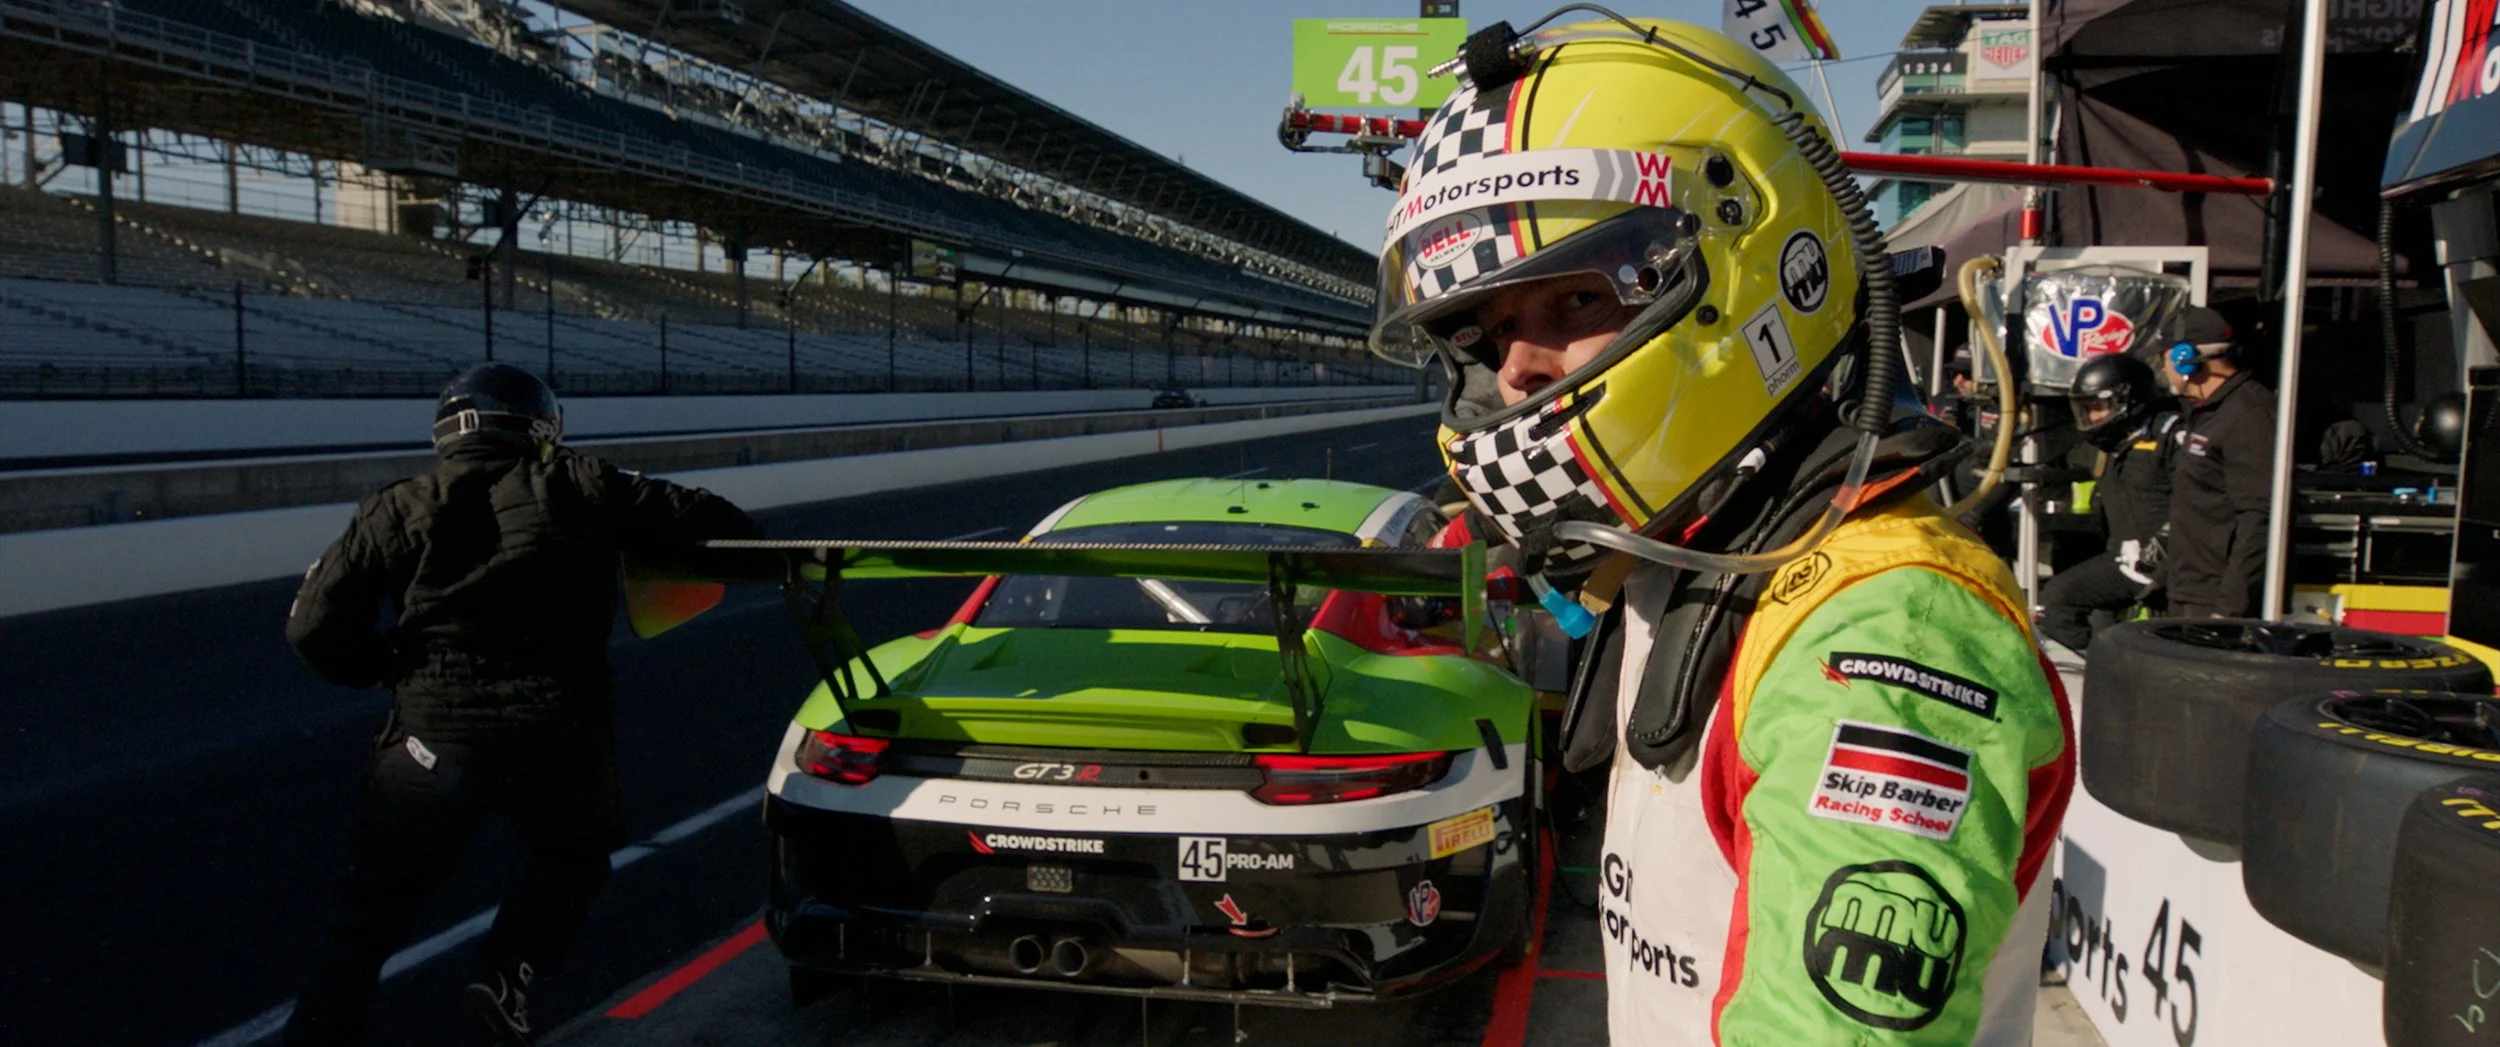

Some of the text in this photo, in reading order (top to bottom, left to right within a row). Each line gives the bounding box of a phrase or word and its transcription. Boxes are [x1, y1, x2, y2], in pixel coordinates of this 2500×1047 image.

[1986, 31, 2028, 46] TAG
[1337, 45, 1418, 105] 45
[1904, 63, 1952, 74] 1 2 3 4
[1421, 220, 1471, 258] BELL
[1454, 328, 1479, 343] BELL
[2049, 299, 2105, 358] VP
[1767, 360, 1800, 396] phorm
[1839, 659, 1988, 710] CROWDSTRIKE
[939, 794, 1157, 816] PORSCHE
[1815, 795, 1883, 822] Racing
[1825, 772, 1963, 813] Skip Barber
[986, 833, 1104, 853] CROWDSTRIKE
[1435, 813, 1490, 852] PIRELLI
[1182, 840, 1294, 878] 45 PRO-AM
[2143, 896, 2202, 1047] 45
